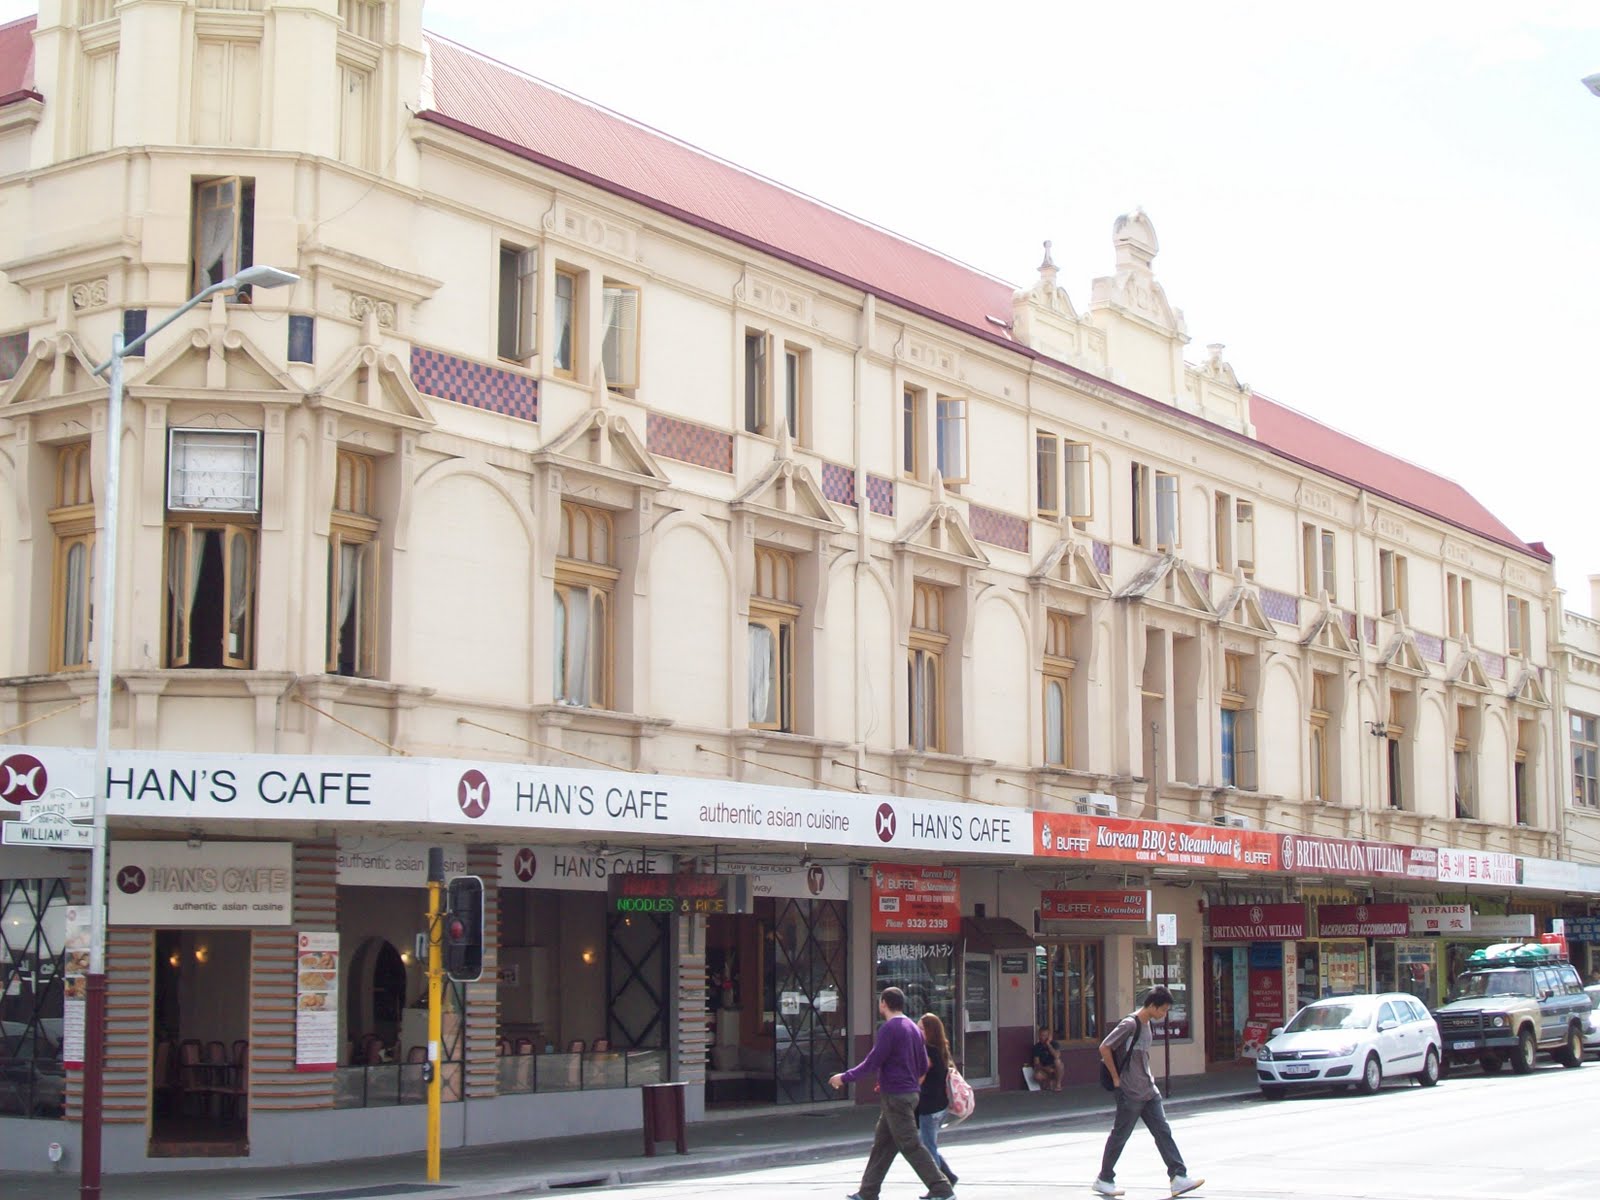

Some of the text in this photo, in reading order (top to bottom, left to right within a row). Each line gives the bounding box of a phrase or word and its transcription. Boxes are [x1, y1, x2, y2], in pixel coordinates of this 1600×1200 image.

[107, 768, 371, 805] HAN'S CAFE
[516, 782, 669, 821] HAN'S CAFE
[699, 802, 850, 832] authentic asian cuisine
[21, 827, 62, 841] WILLIAM
[912, 813, 1011, 843] HAN'S CAFE
[1057, 836, 1091, 852] BUFFET
[1096, 825, 1139, 848] Korean
[1142, 829, 1166, 856] BBQ
[1168, 832, 1177, 851] &
[1179, 832, 1233, 855] Steamboat
[339, 854, 465, 873] authentic asian sine
[1191, 855, 1205, 864] TABLE
[1244, 851, 1272, 865] BUFFET
[1296, 840, 1349, 869] BRITANNIA
[1350, 844, 1365, 871] ON
[1366, 846, 1404, 873] WILLIAM
[553, 855, 606, 878] HAN'S
[150, 867, 288, 893] HAN'S CAFE
[888, 879, 918, 890] BUFFET
[172, 902, 217, 911] authentic
[222, 902, 247, 911] asian
[617, 898, 724, 912] NOODLES & RICE
[1123, 896, 1142, 906] BBQ
[1057, 903, 1092, 913] BUFFET
[1103, 906, 1145, 914] Steamboat
[1421, 906, 1466, 914] AFFAIRS
[907, 918, 927, 928] 9328
[928, 918, 948, 928] 2398
[1320, 924, 1359, 936] BACKPACKERS
[1213, 924, 1303, 938] BRITANNIA ON WILLIAM
[1142, 964, 1178, 979] INTERET
